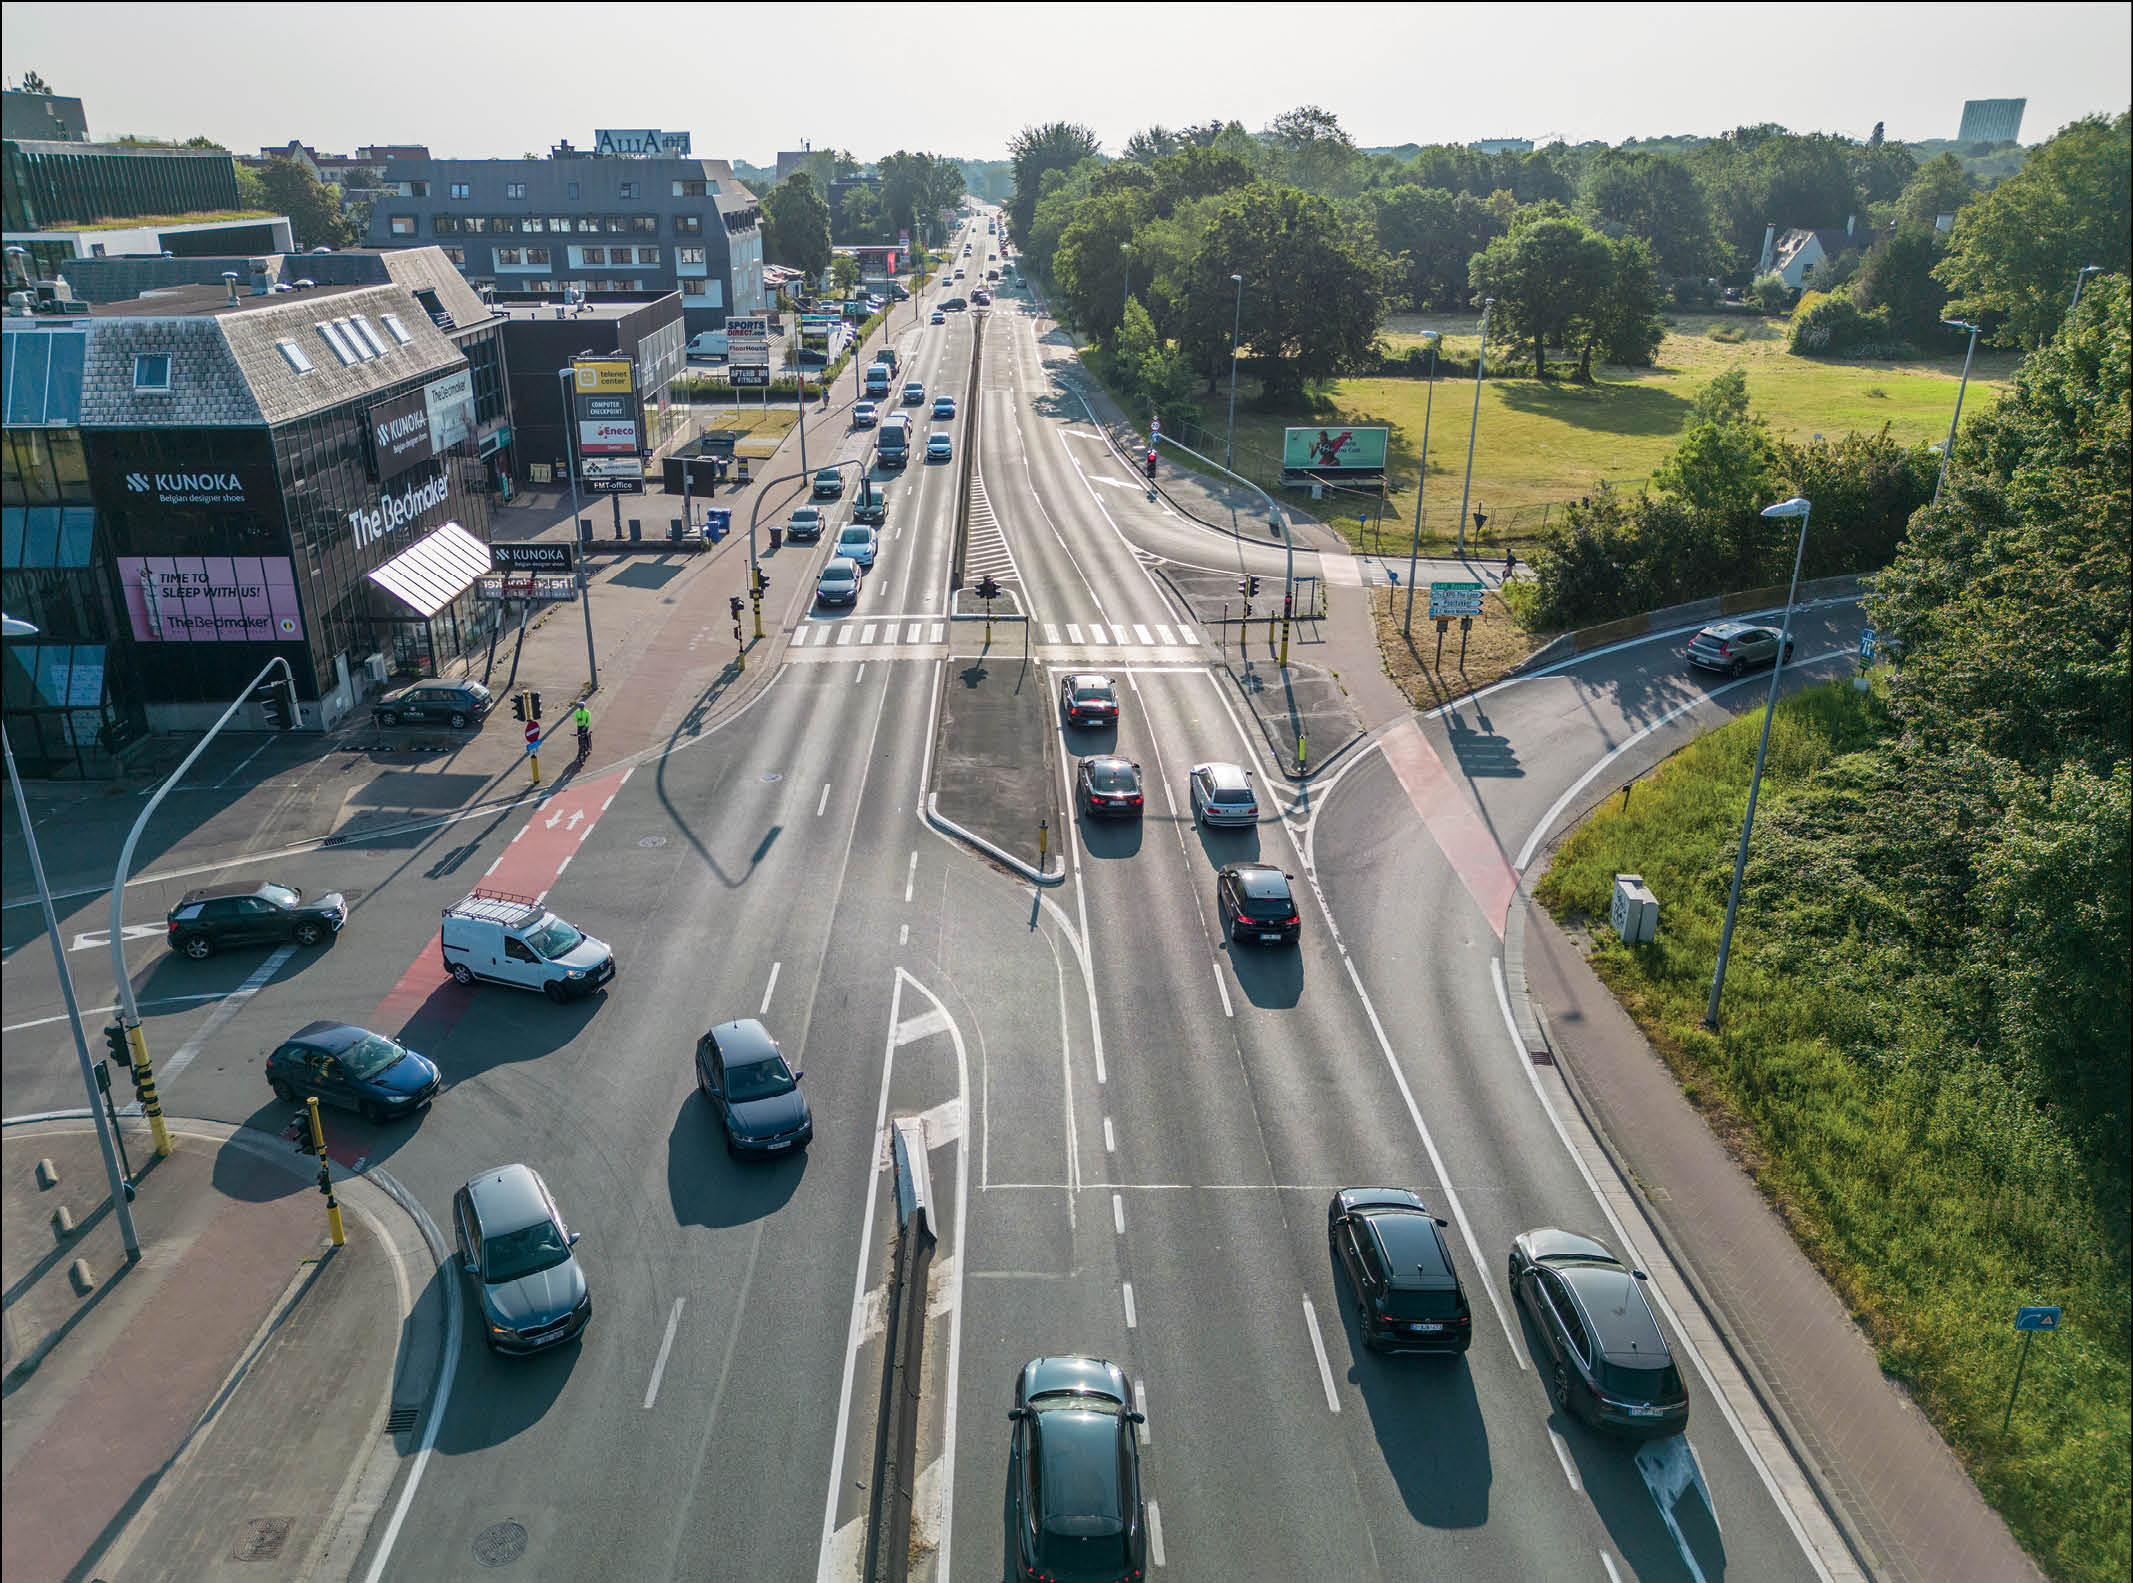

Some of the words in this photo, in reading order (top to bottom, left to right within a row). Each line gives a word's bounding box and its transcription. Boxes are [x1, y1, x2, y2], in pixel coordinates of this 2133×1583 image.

[728, 321, 765, 329] SPORTS
[389, 410, 426, 441] KUNOKA
[604, 427, 634, 435] Eneco
[155, 473, 243, 491] KUNOKA
[593, 481, 633, 489] FMT-office
[160, 494, 187, 504] Belgian
[189, 494, 221, 504] designer
[222, 494, 245, 502] shoes
[512, 549, 564, 560] KUNOKA
[160, 573, 189, 584] TIME
[192, 573, 209, 584] TO
[162, 587, 201, 598] SLEEP
[203, 587, 237, 598] WITH
[241, 587, 261, 598] US!
